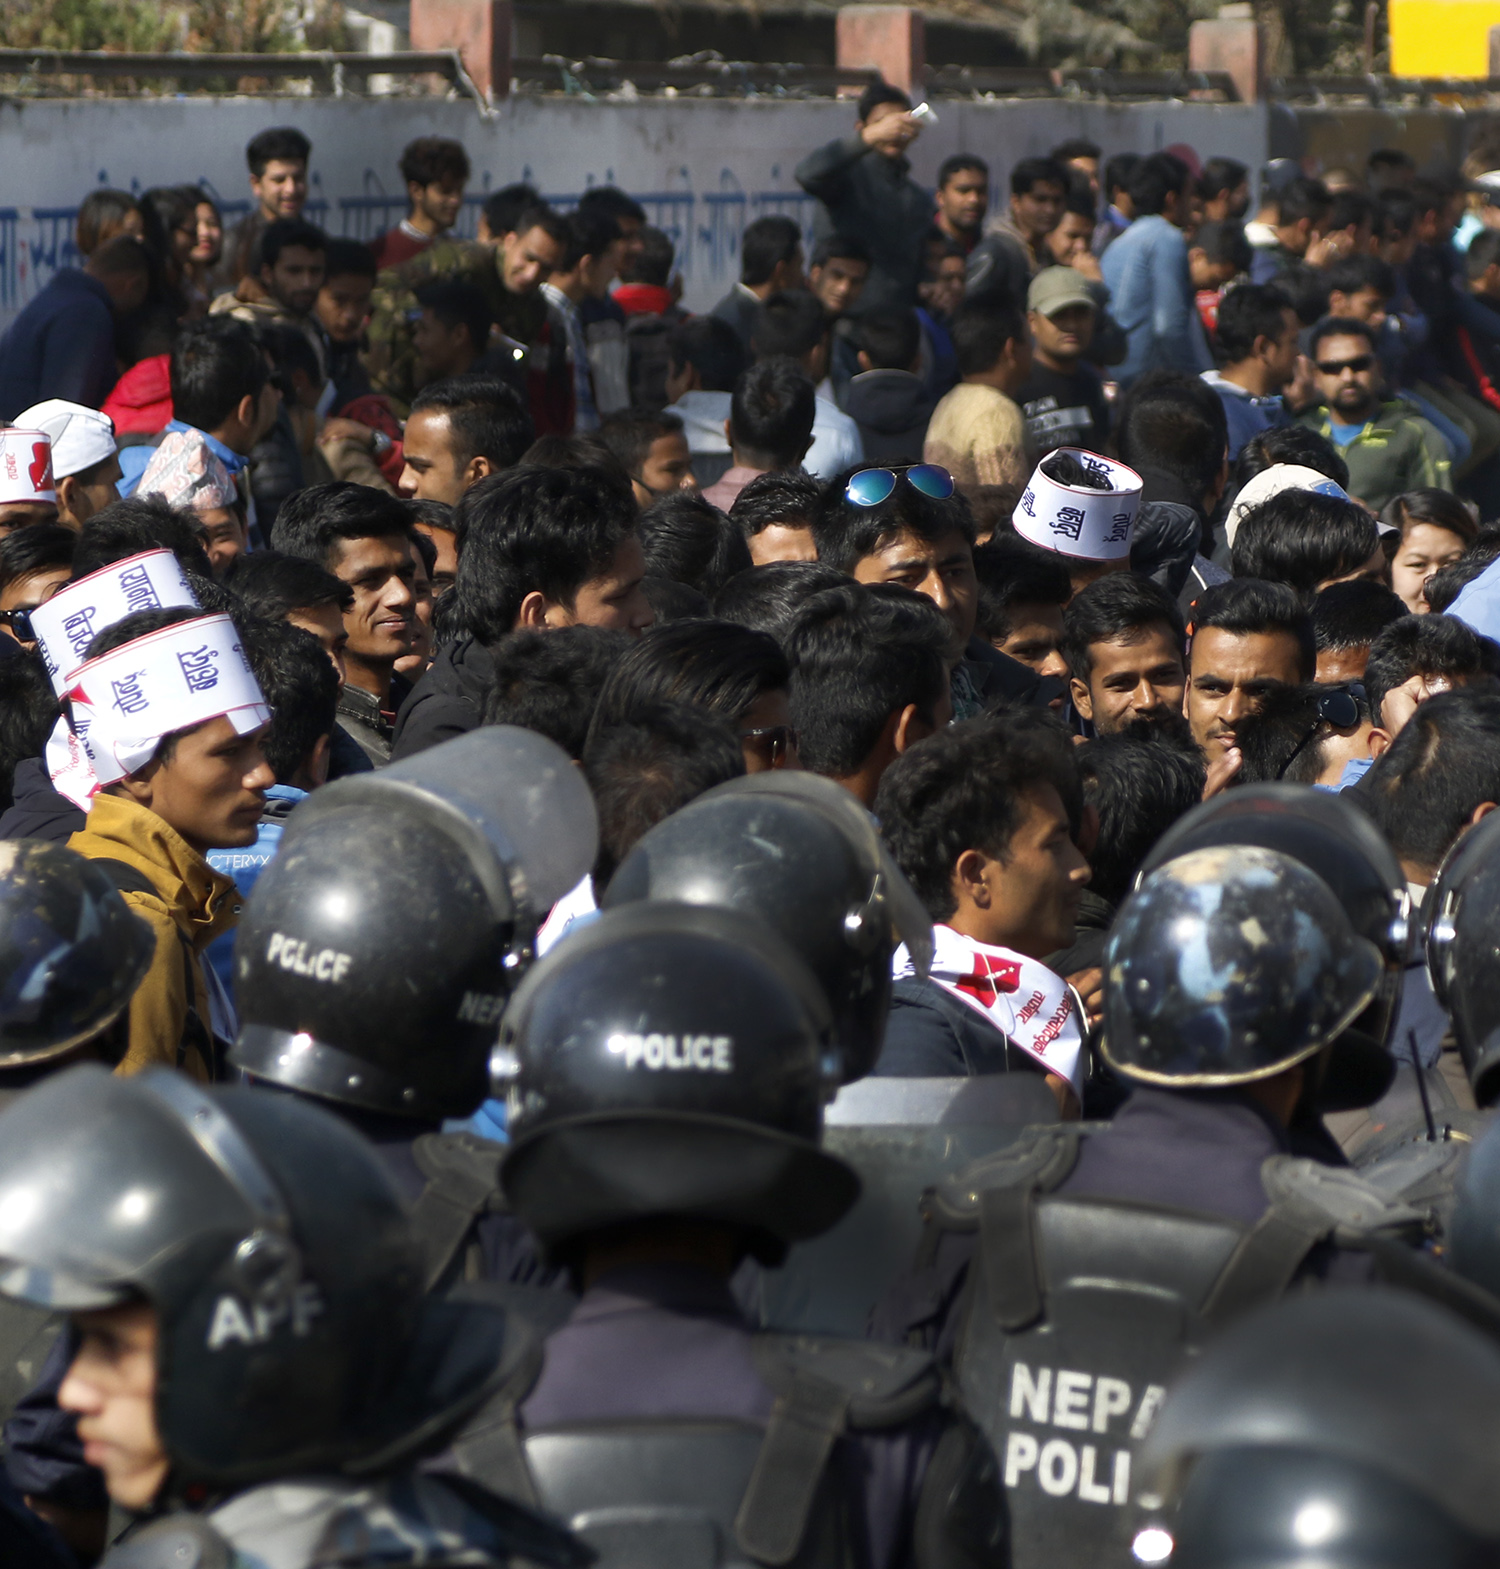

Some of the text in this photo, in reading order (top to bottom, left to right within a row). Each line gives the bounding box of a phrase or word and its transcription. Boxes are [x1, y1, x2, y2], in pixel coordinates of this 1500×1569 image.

[1049, 507, 1086, 541] बहादुर
[111, 668, 150, 717] तपेन्द्र
[176, 645, 219, 694] बहादुर
[624, 1033, 731, 1071] POLICE
[207, 1282, 322, 1350] APF
[1005, 1431, 1130, 1505] POLI
